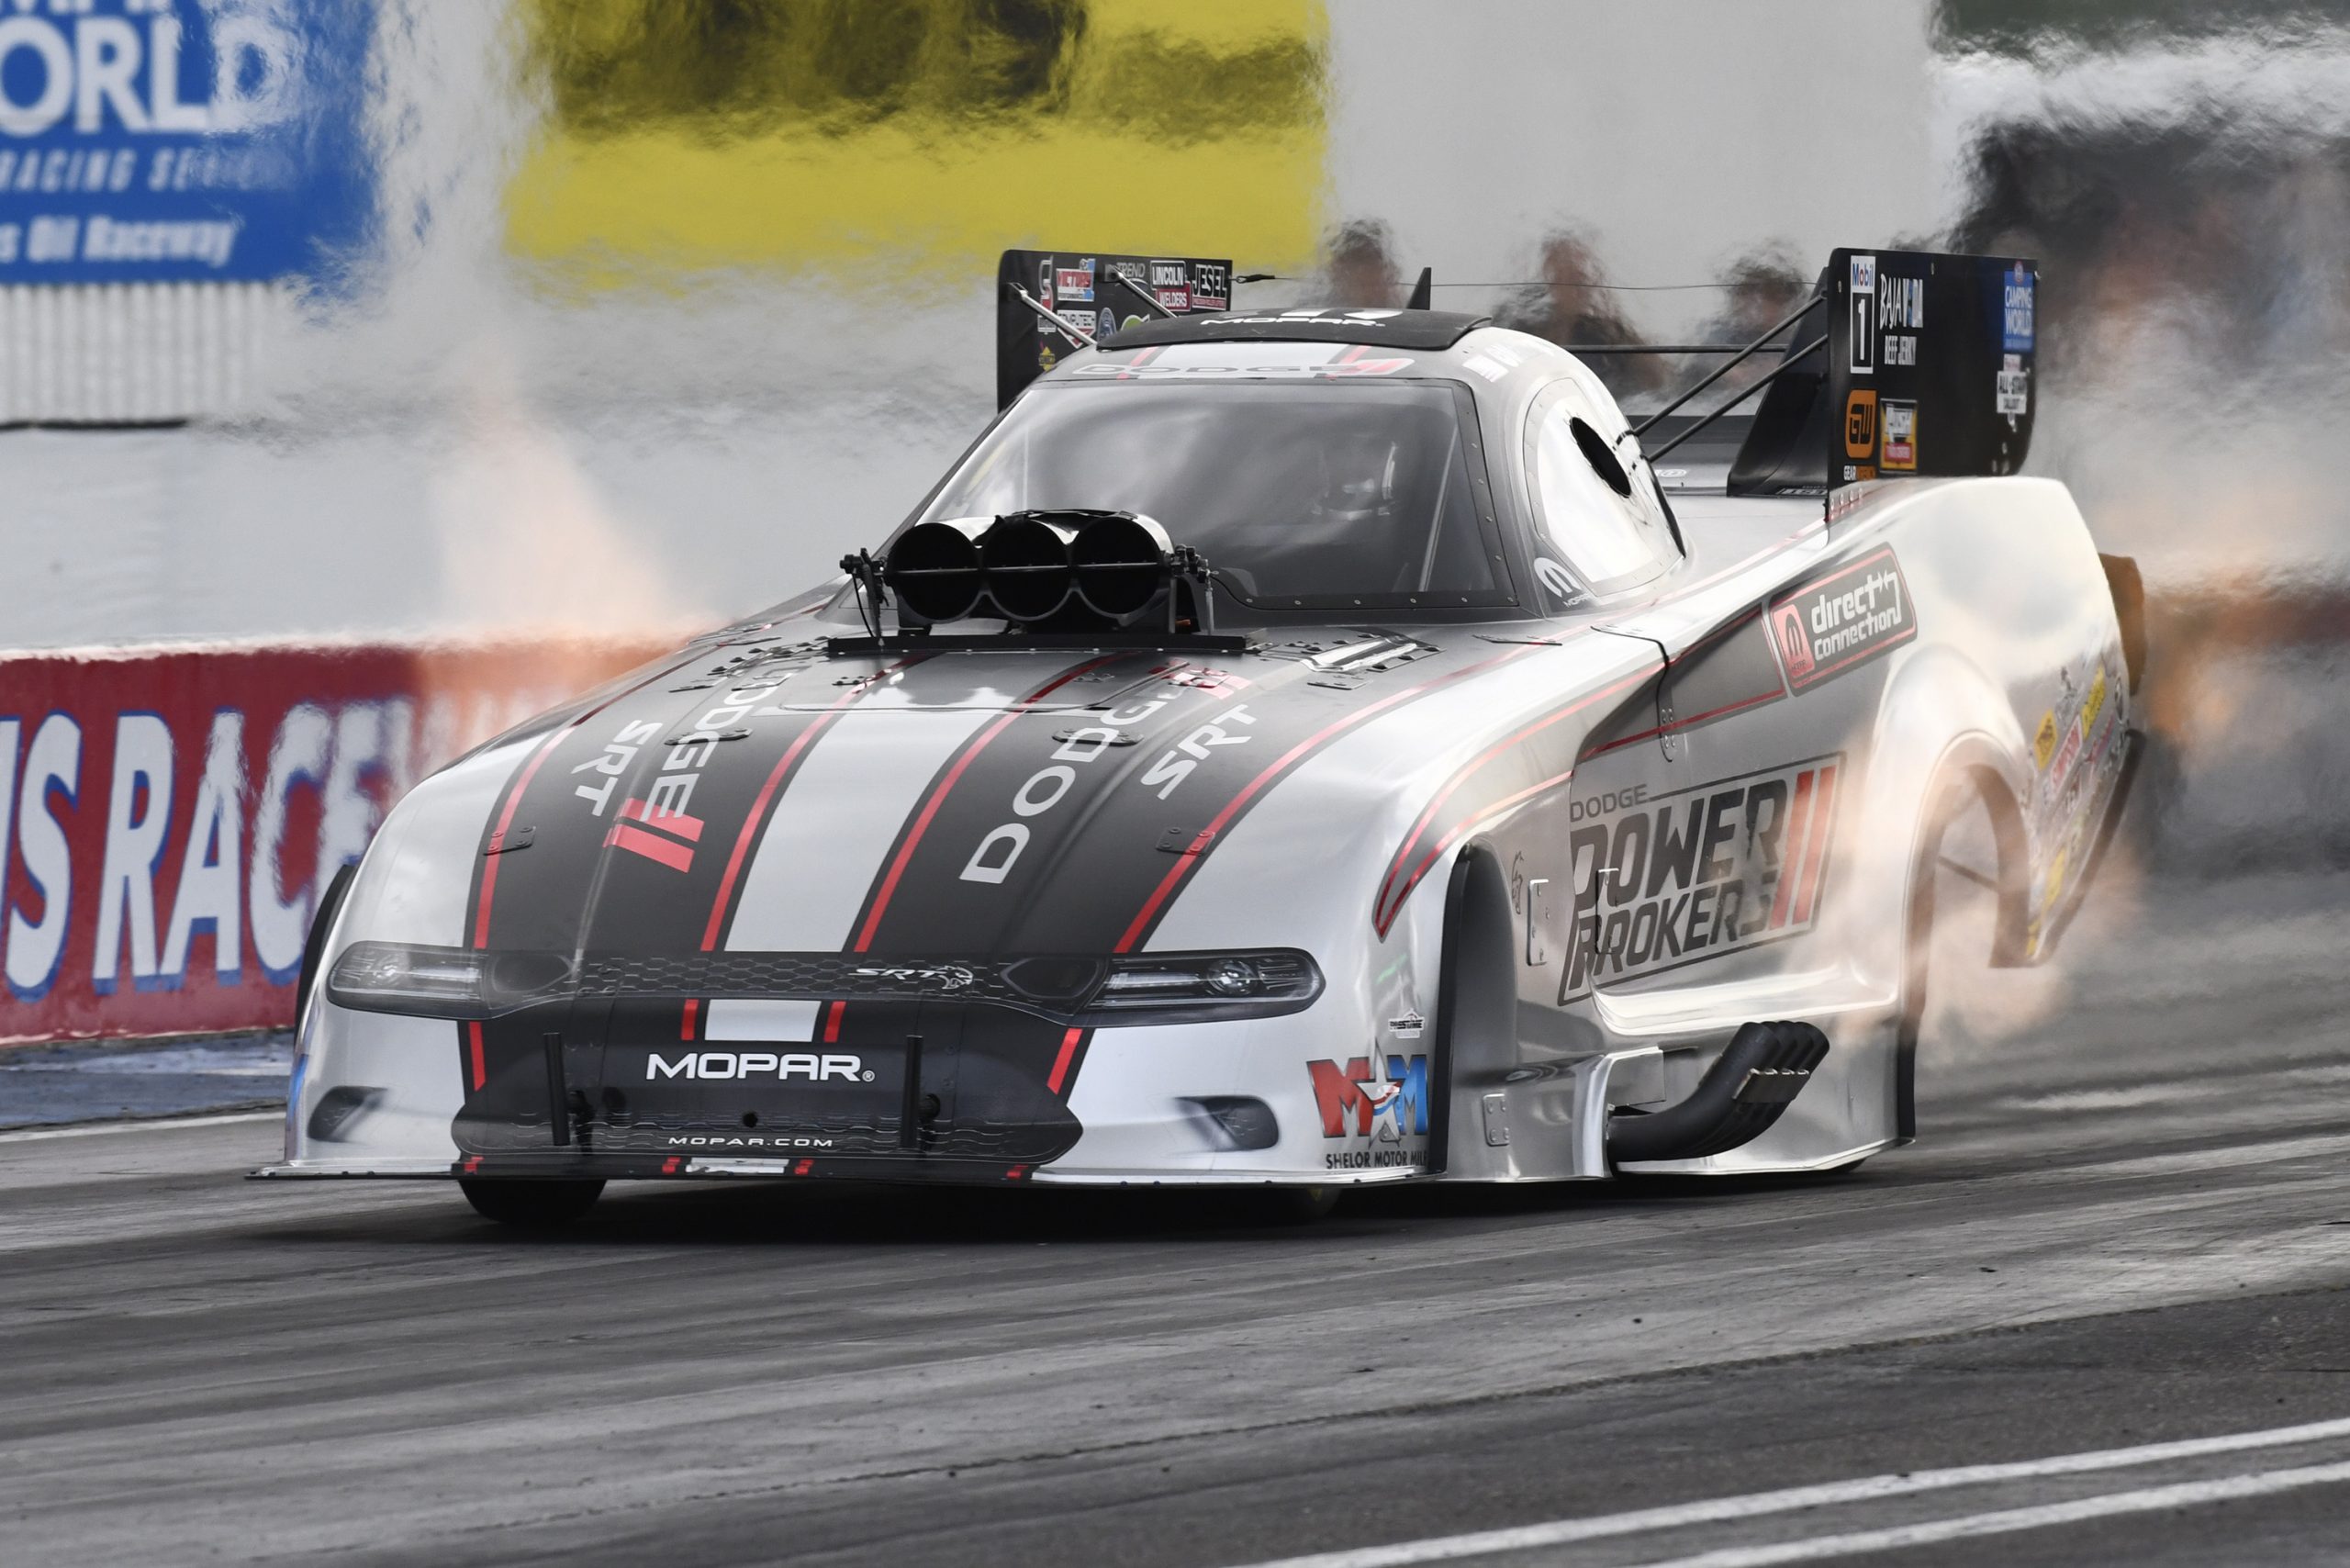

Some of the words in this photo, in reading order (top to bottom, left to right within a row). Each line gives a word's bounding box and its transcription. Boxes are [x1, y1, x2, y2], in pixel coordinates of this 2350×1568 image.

[1152, 265, 1184, 286] LINCOLN
[1192, 263, 1227, 298] JESEL
[1852, 263, 1874, 287] Mobil
[1158, 291, 1188, 308] WELDERS
[2005, 286, 2032, 308] CAMPING
[1858, 298, 1866, 361] 1
[2004, 308, 2032, 338] WORLD
[1884, 335, 1898, 365] BEEF
[1811, 572, 1884, 634] direct
[1814, 600, 1902, 661] connection
[571, 720, 663, 816] SRT
[1140, 703, 1257, 801] SRT
[1571, 784, 1649, 823] DODGE
[93, 703, 454, 996] RACE
[1570, 778, 1788, 912] POWER
[1568, 869, 1778, 991] BROKERS
[848, 968, 946, 980] SRT
[668, 1137, 833, 1148] MOPAR.COM
[1326, 1152, 1371, 1170] SHELOR
[1374, 1150, 1408, 1168] MOTOR
